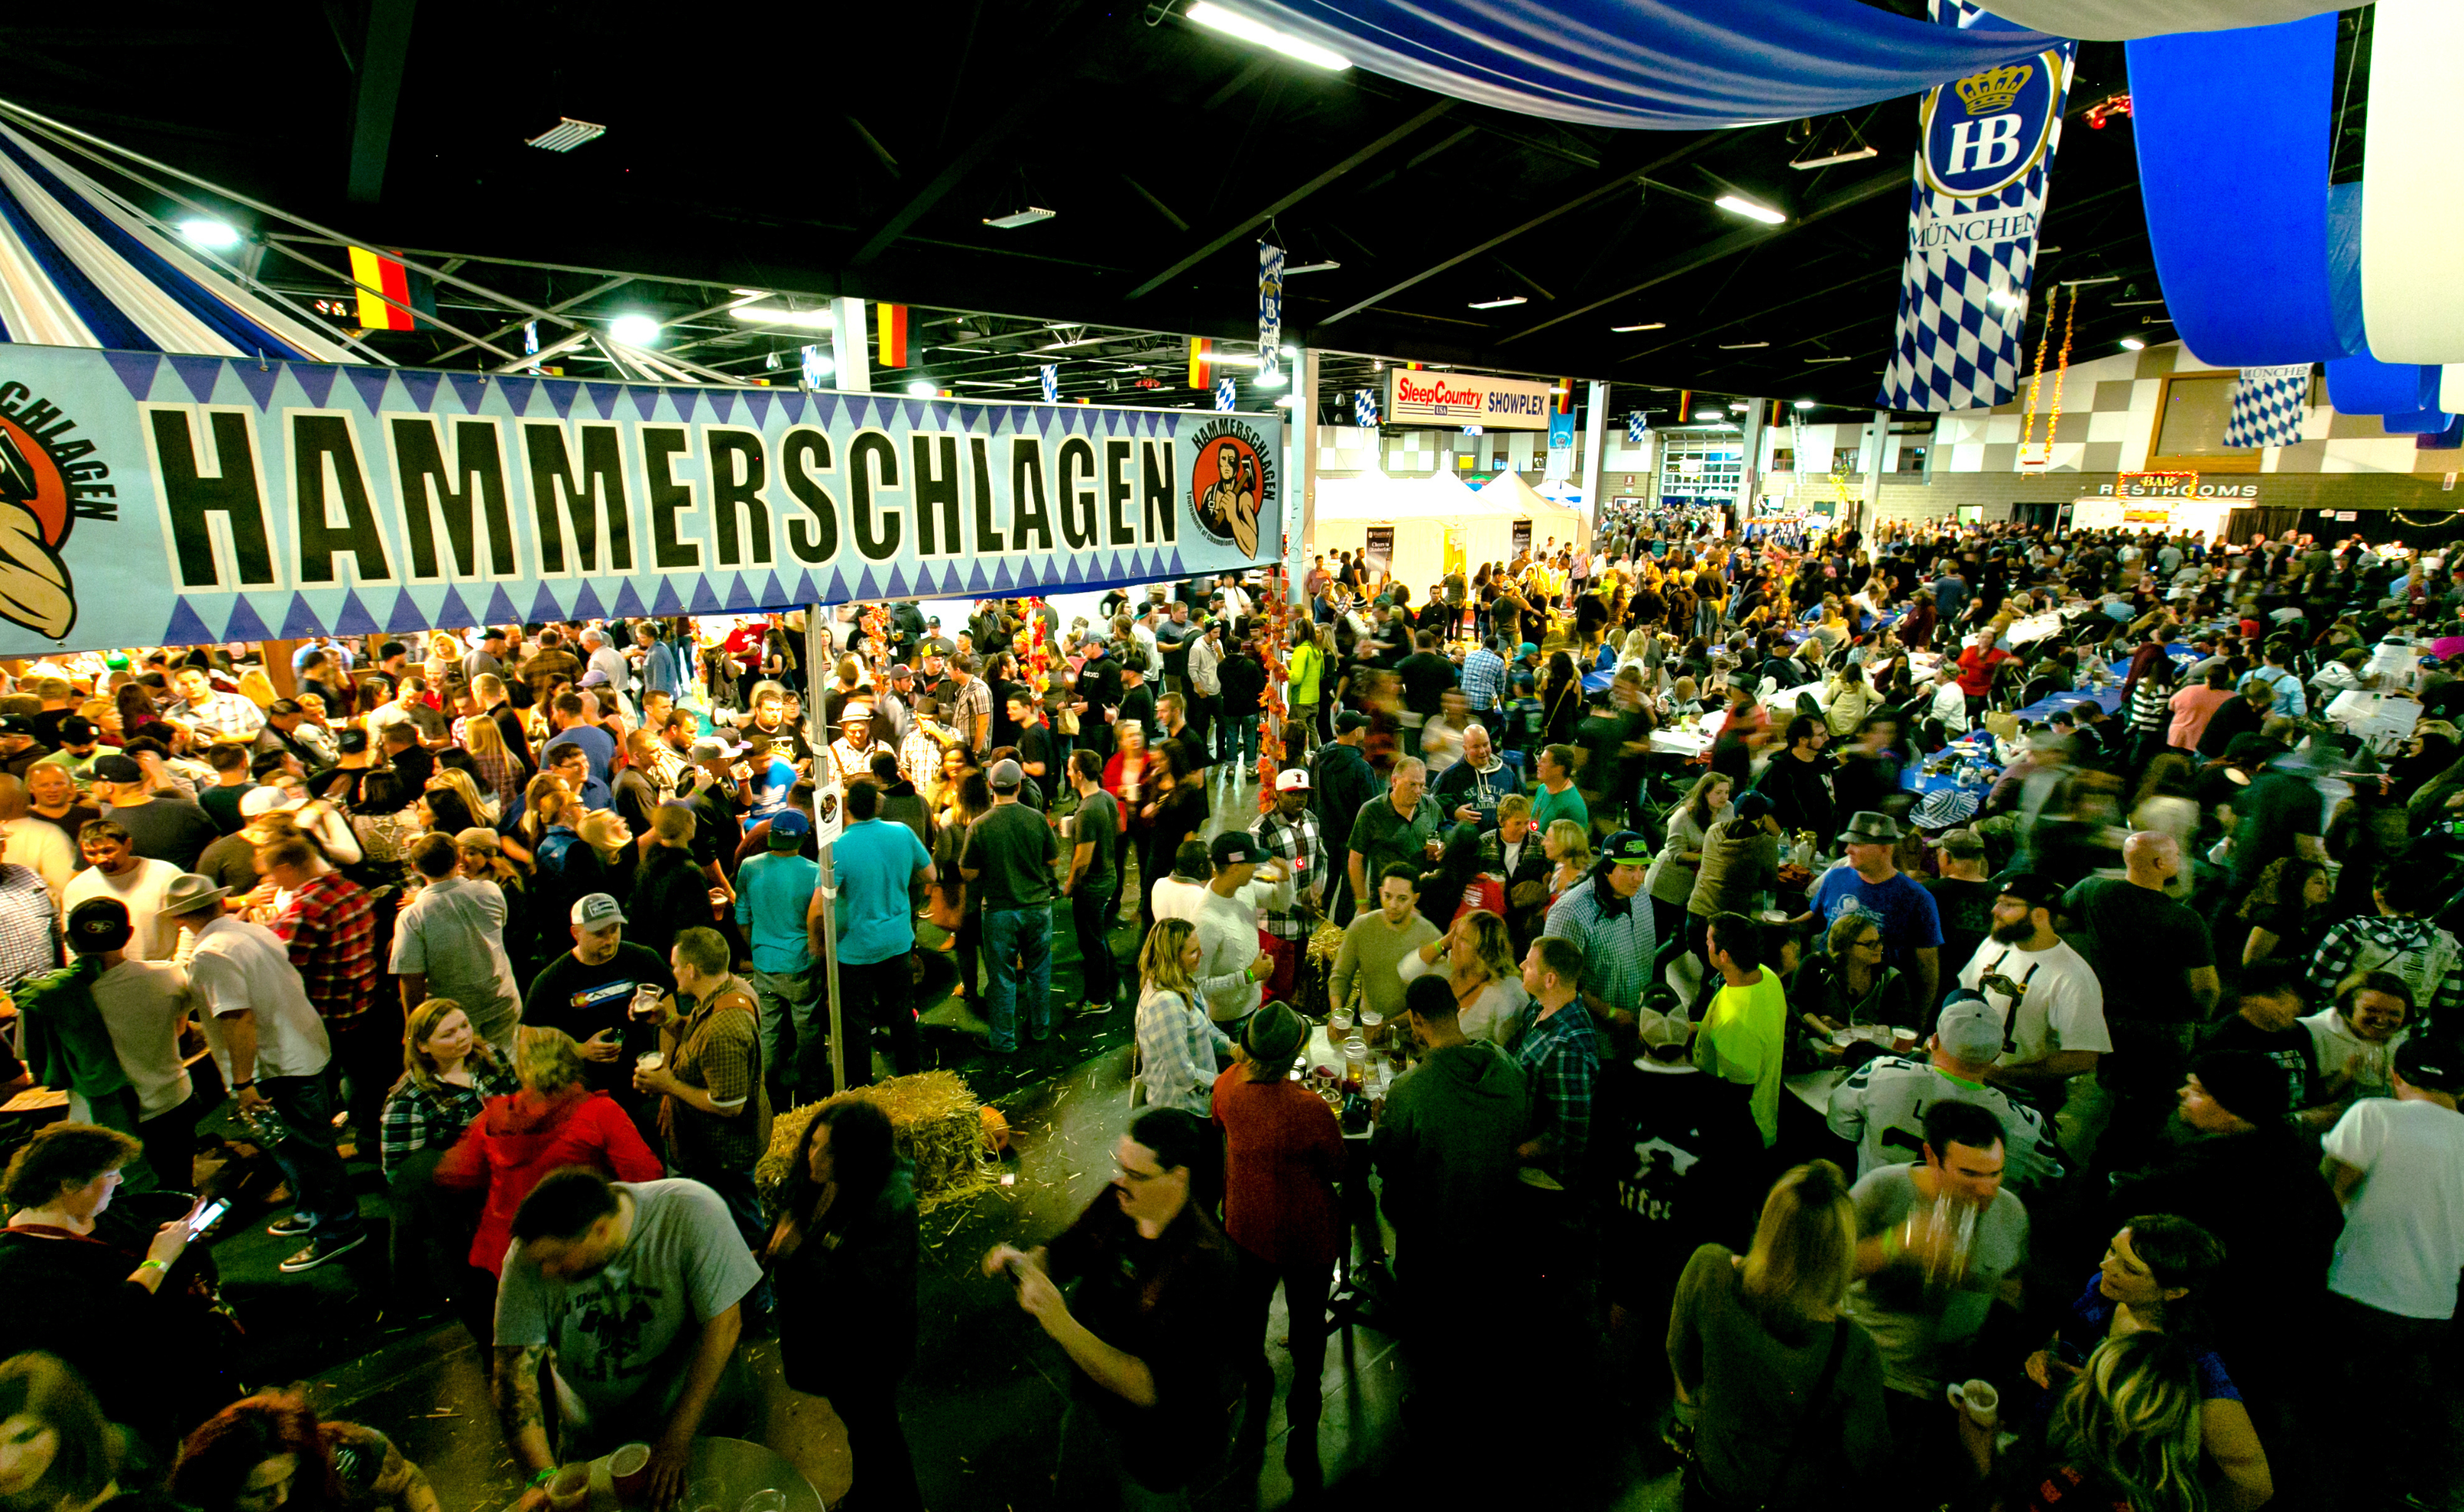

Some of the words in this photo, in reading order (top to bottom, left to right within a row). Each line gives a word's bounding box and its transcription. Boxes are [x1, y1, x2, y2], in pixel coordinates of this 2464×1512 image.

[1945, 113, 2022, 176] HB
[1909, 210, 2040, 247] MÜNCHEN
[2243, 366, 2308, 378] MÜNCHE
[1398, 377, 1483, 410] SleepCountry
[1488, 391, 1545, 416] SHOWPLEX
[1435, 406, 1447, 415] USA
[1191, 417, 1276, 501] HAMMERSCHLAGEN
[139, 402, 1177, 593] HAMMERSCHLAGEN
[2099, 484, 2258, 497] RESTROOMS
[2143, 475, 2175, 488] BAR
[1186, 490, 1203, 532] Tournament
[1207, 533, 1234, 547] Champions
